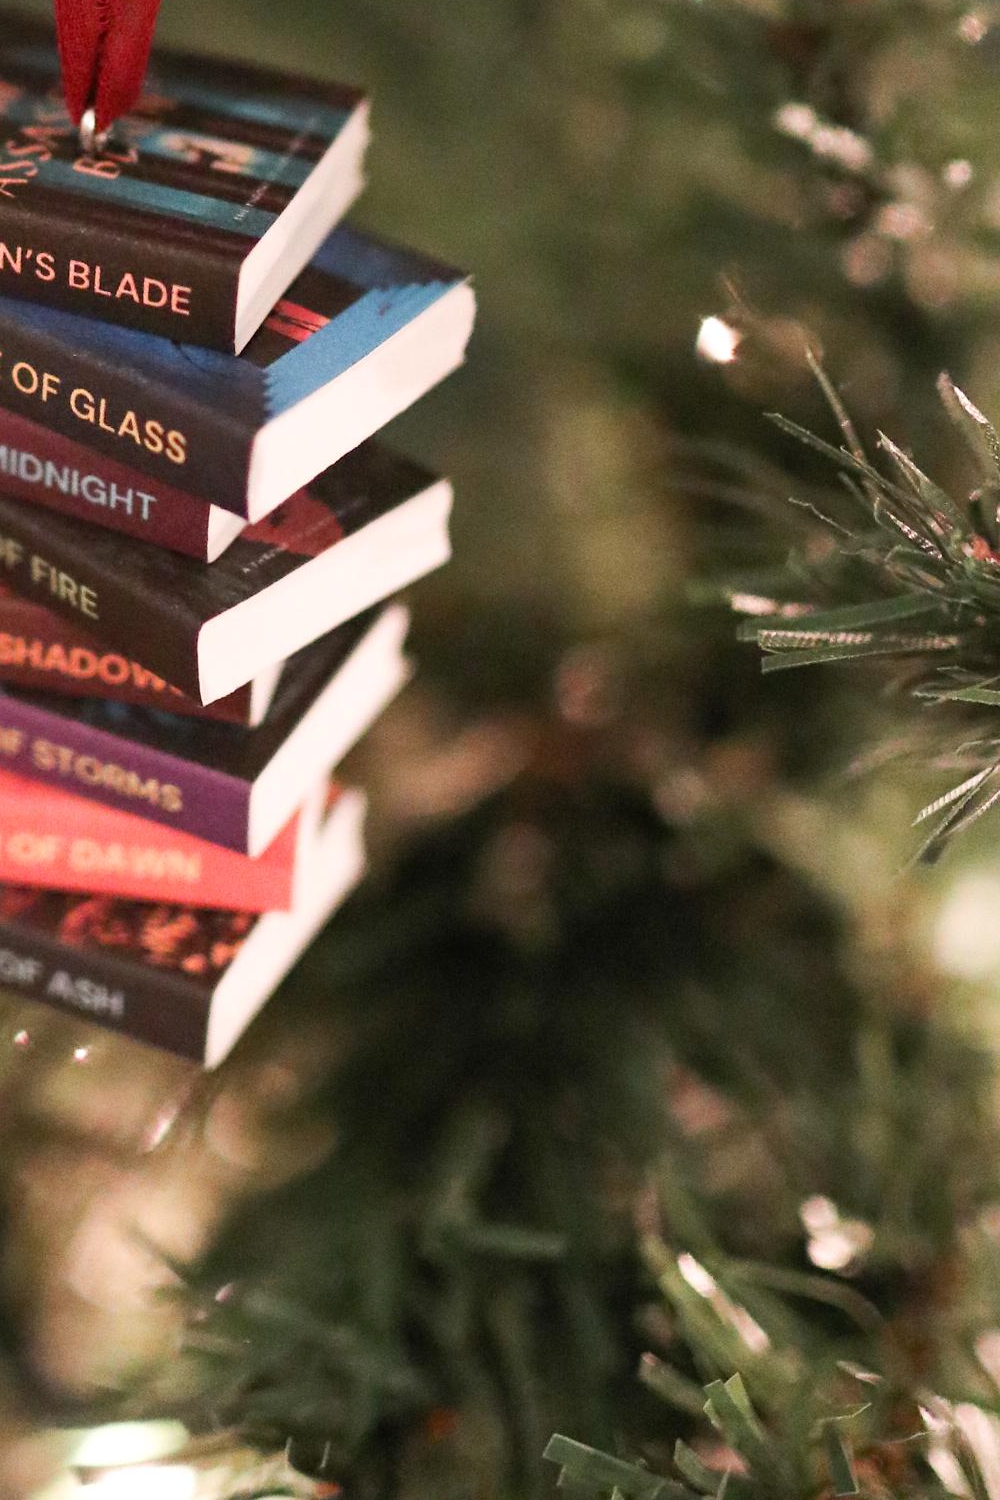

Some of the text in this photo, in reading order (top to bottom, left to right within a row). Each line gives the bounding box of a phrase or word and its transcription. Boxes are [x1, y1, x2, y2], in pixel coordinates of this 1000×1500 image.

[68, 259, 193, 316] BLADE
[12, 361, 61, 403] OF
[70, 388, 187, 465] GLASS
[31, 554, 100, 620] FIRE
[31, 737, 184, 814] STORMS
[6, 832, 58, 865] OF
[68, 839, 202, 883] DAWN
[49, 969, 125, 1019] ASH
